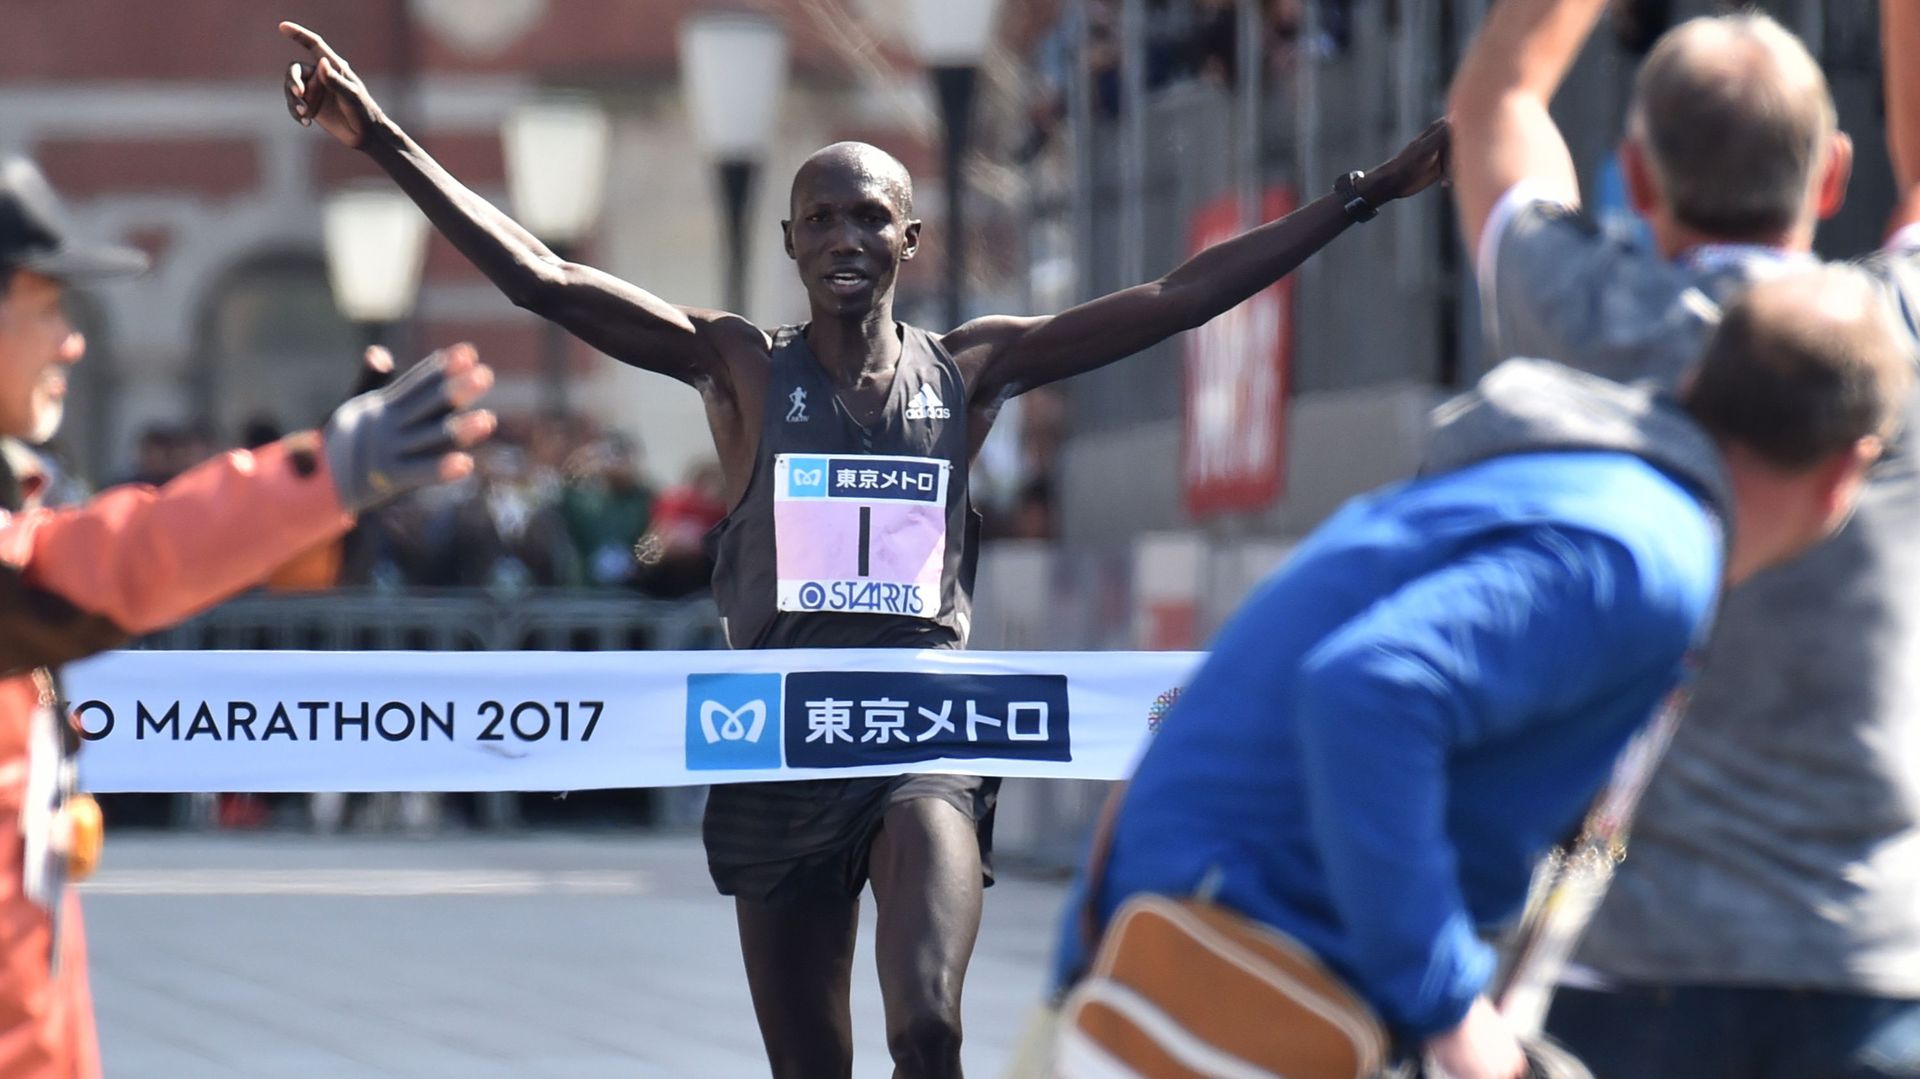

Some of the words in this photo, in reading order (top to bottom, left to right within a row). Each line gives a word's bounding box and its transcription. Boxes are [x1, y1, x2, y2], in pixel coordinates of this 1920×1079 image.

[835, 468, 934, 491] 東京メトロ
[858, 506, 871, 577] 1
[66, 700, 115, 741] O
[136, 699, 455, 742] MARATHON
[476, 700, 604, 742] 2017
[805, 697, 1049, 744] 東京メトロ
